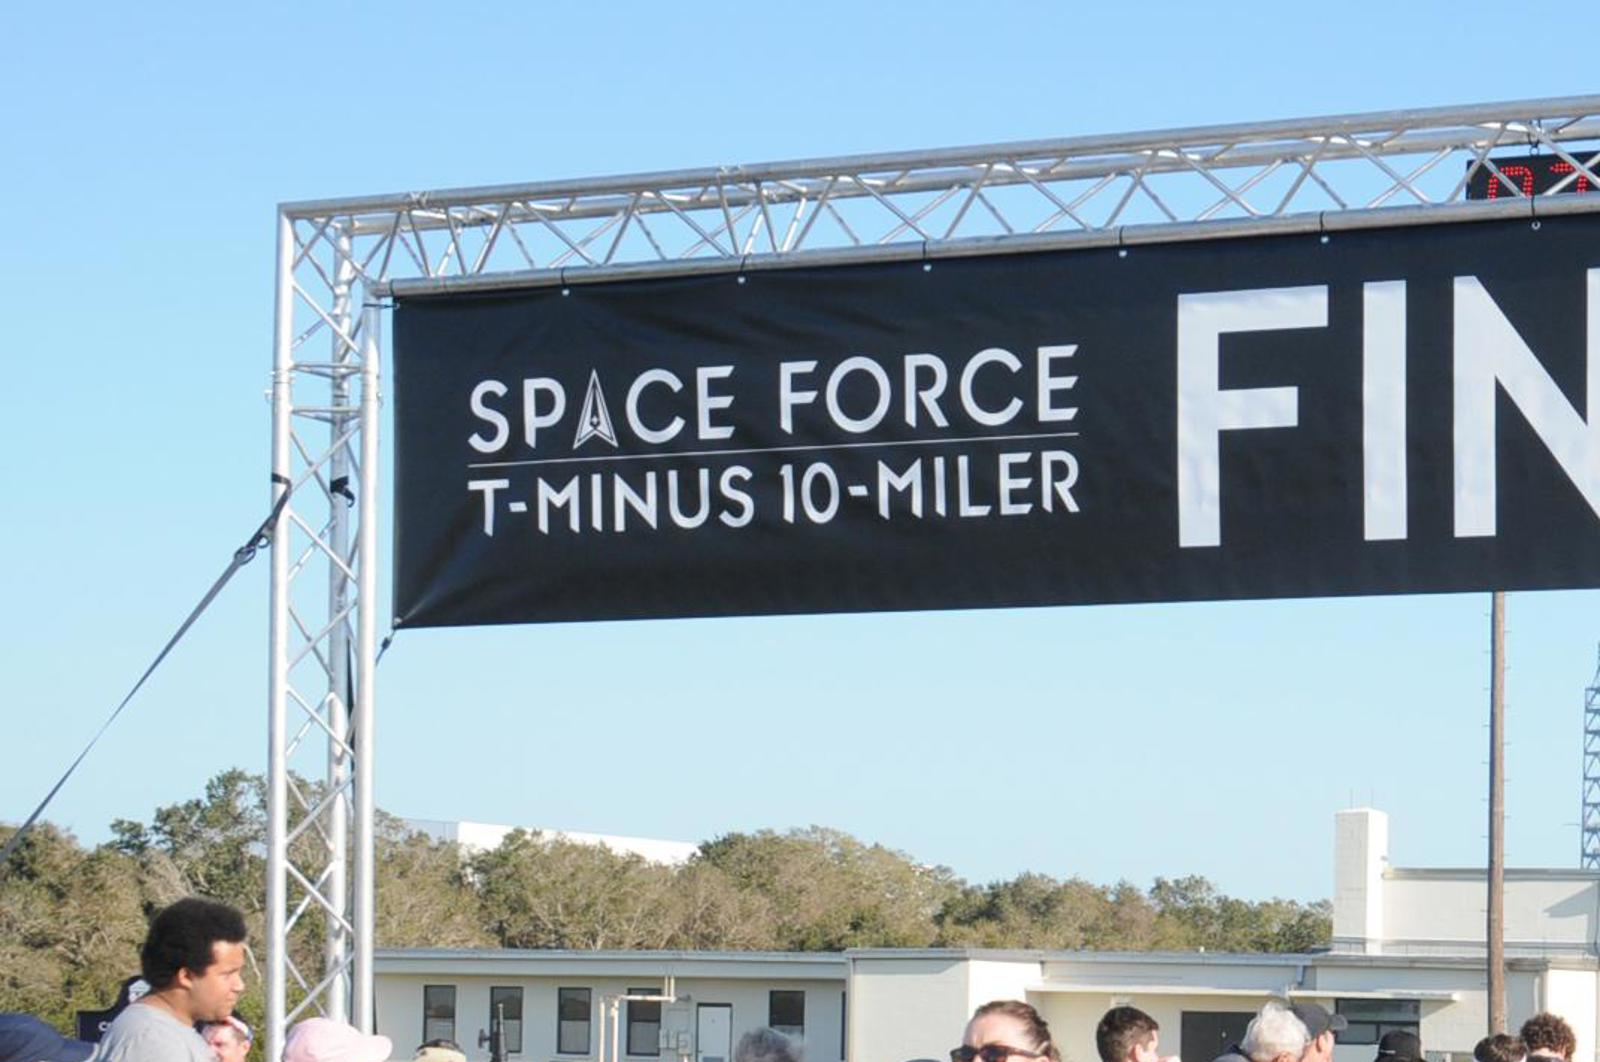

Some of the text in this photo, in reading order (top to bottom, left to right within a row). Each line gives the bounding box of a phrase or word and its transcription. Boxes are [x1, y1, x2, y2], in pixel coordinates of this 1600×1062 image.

[467, 343, 1080, 455] SPACE FORCE
[467, 449, 1081, 537] T-MINUS 10-MILER
